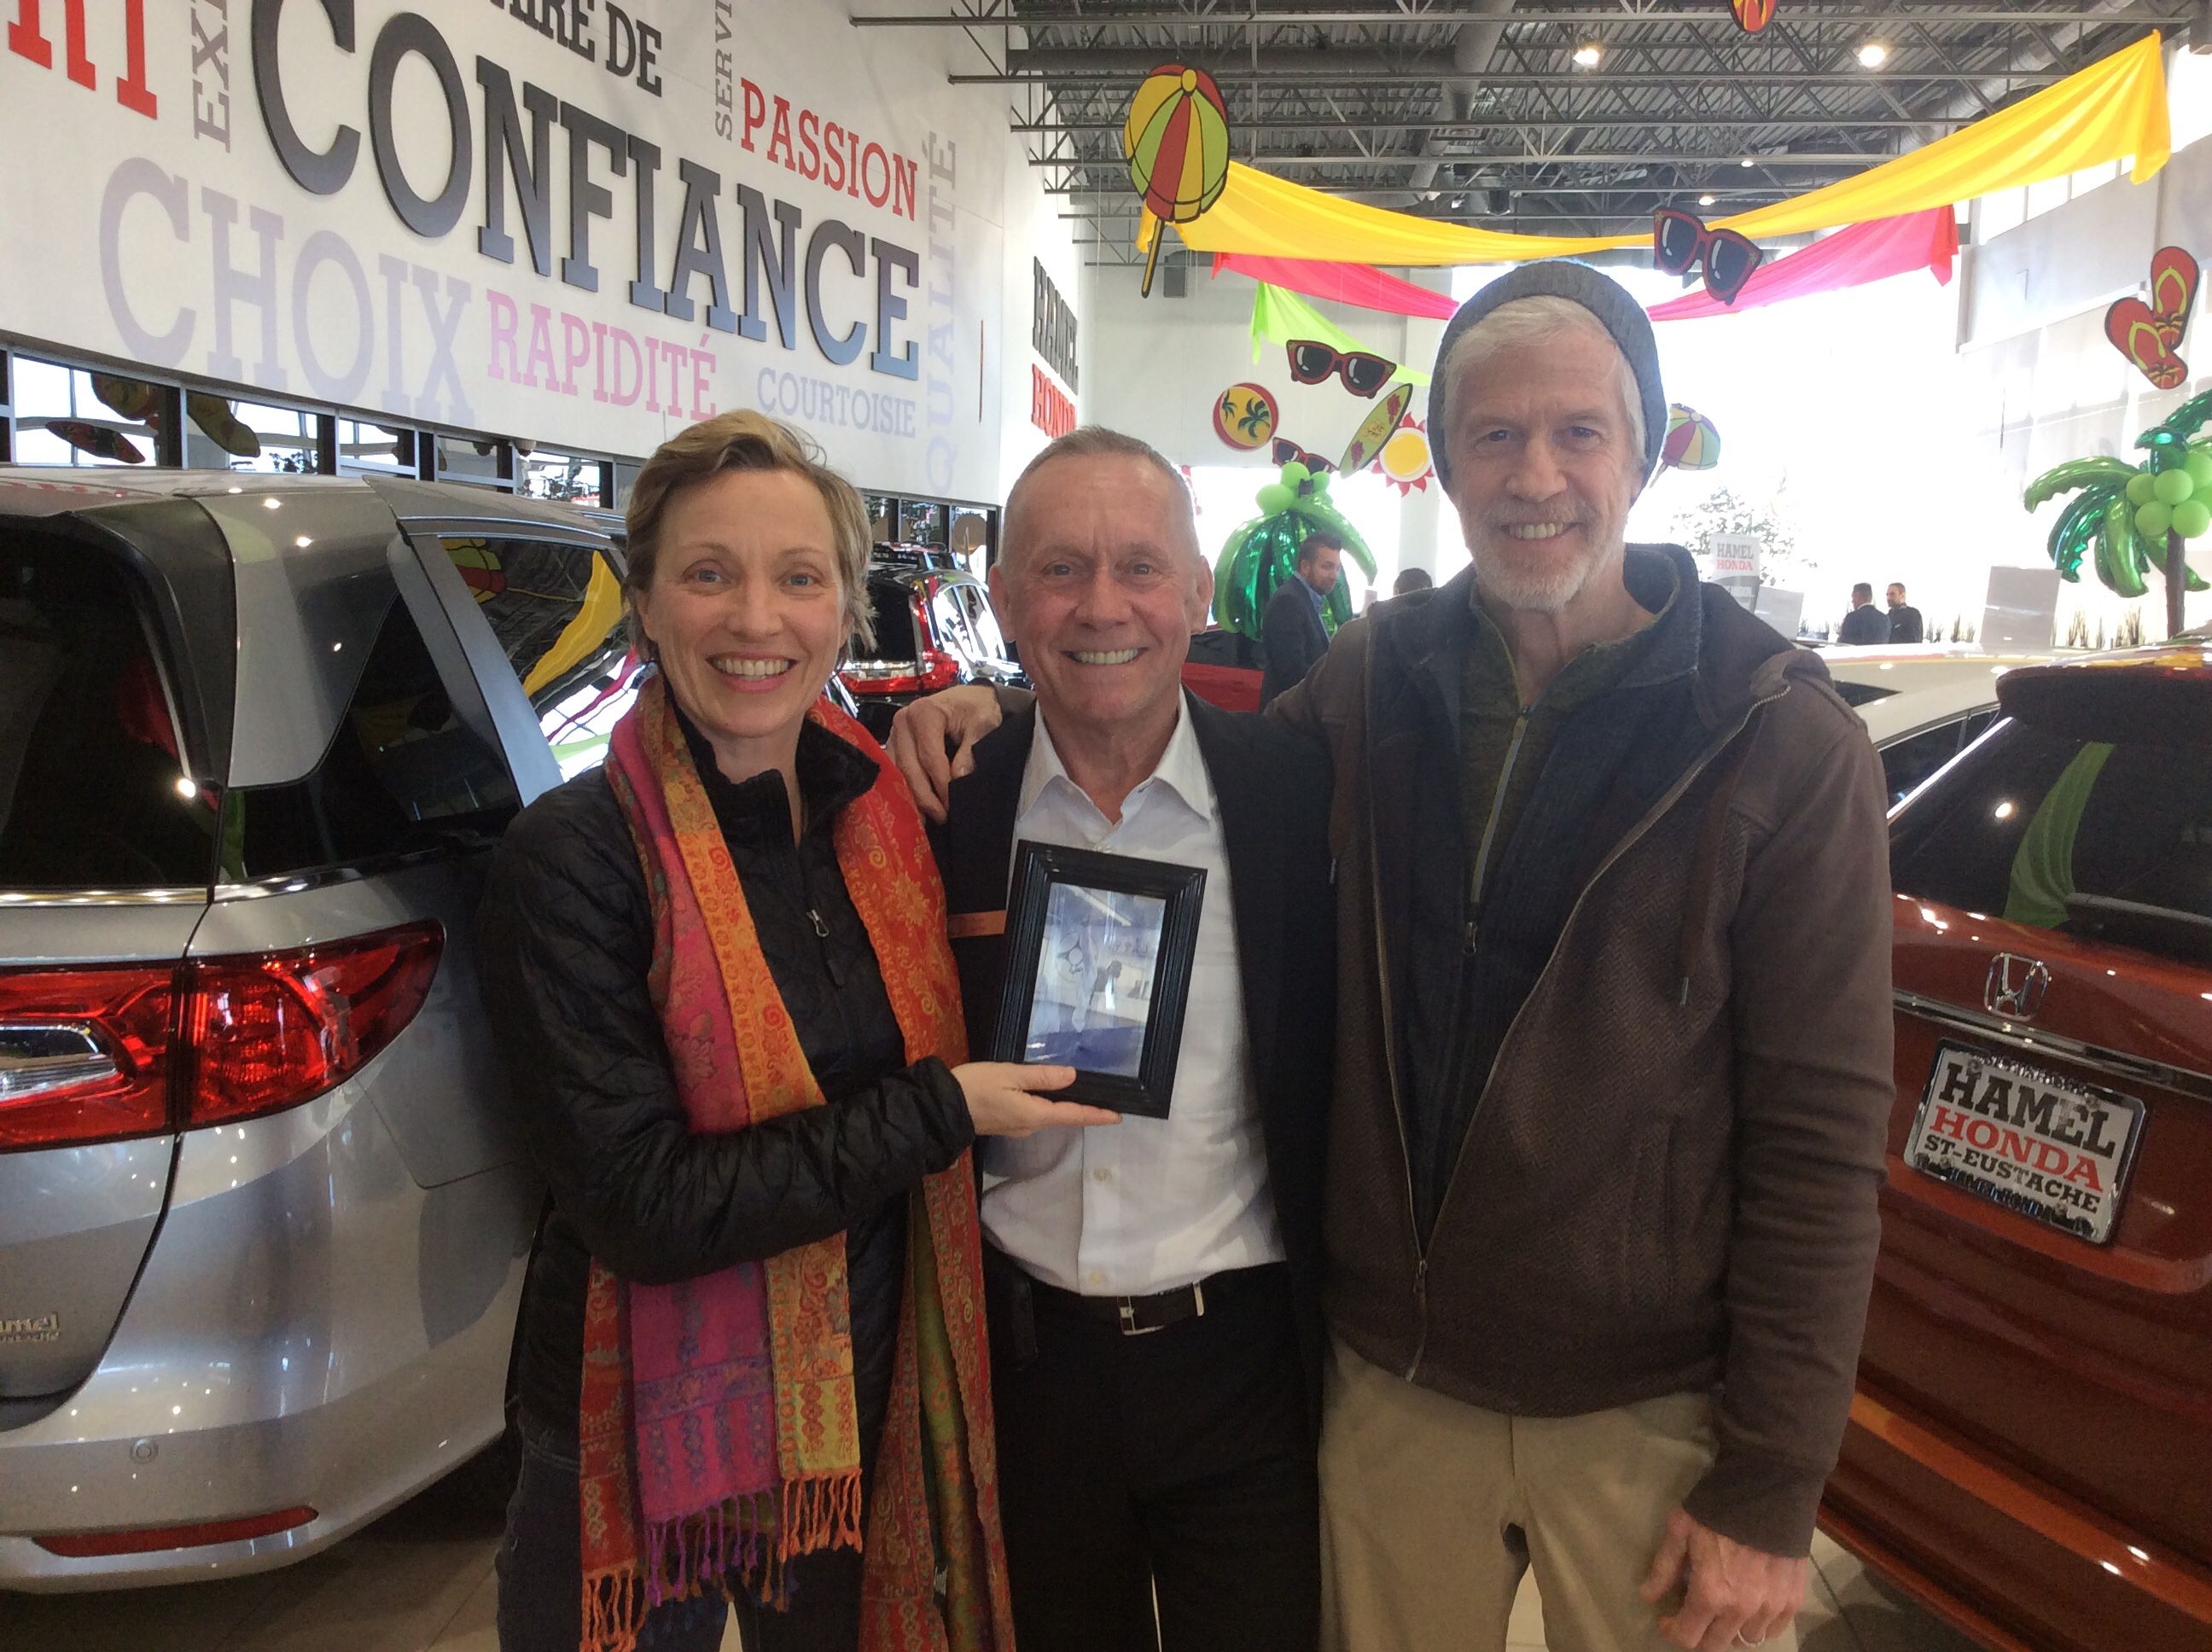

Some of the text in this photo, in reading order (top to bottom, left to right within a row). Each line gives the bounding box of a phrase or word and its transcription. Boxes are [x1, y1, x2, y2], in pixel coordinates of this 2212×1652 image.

[605, 0, 662, 98] DE
[251, 0, 919, 381] CONFIANCE
[741, 77, 918, 222] PASSION
[99, 156, 474, 427] CHOIX
[923, 131, 958, 496] QUALITÉ
[486, 288, 717, 422] RAPIDITÉ
[757, 367, 916, 438] COURTOISIE
[1716, 560, 1753, 571] HONDA
[1717, 543, 1755, 560] HAMEL
[1929, 1104, 2103, 1193] HONDA
[1939, 1062, 2116, 1159] HAMEL
[1924, 1132, 2101, 1214] ST-EUSTACHE
